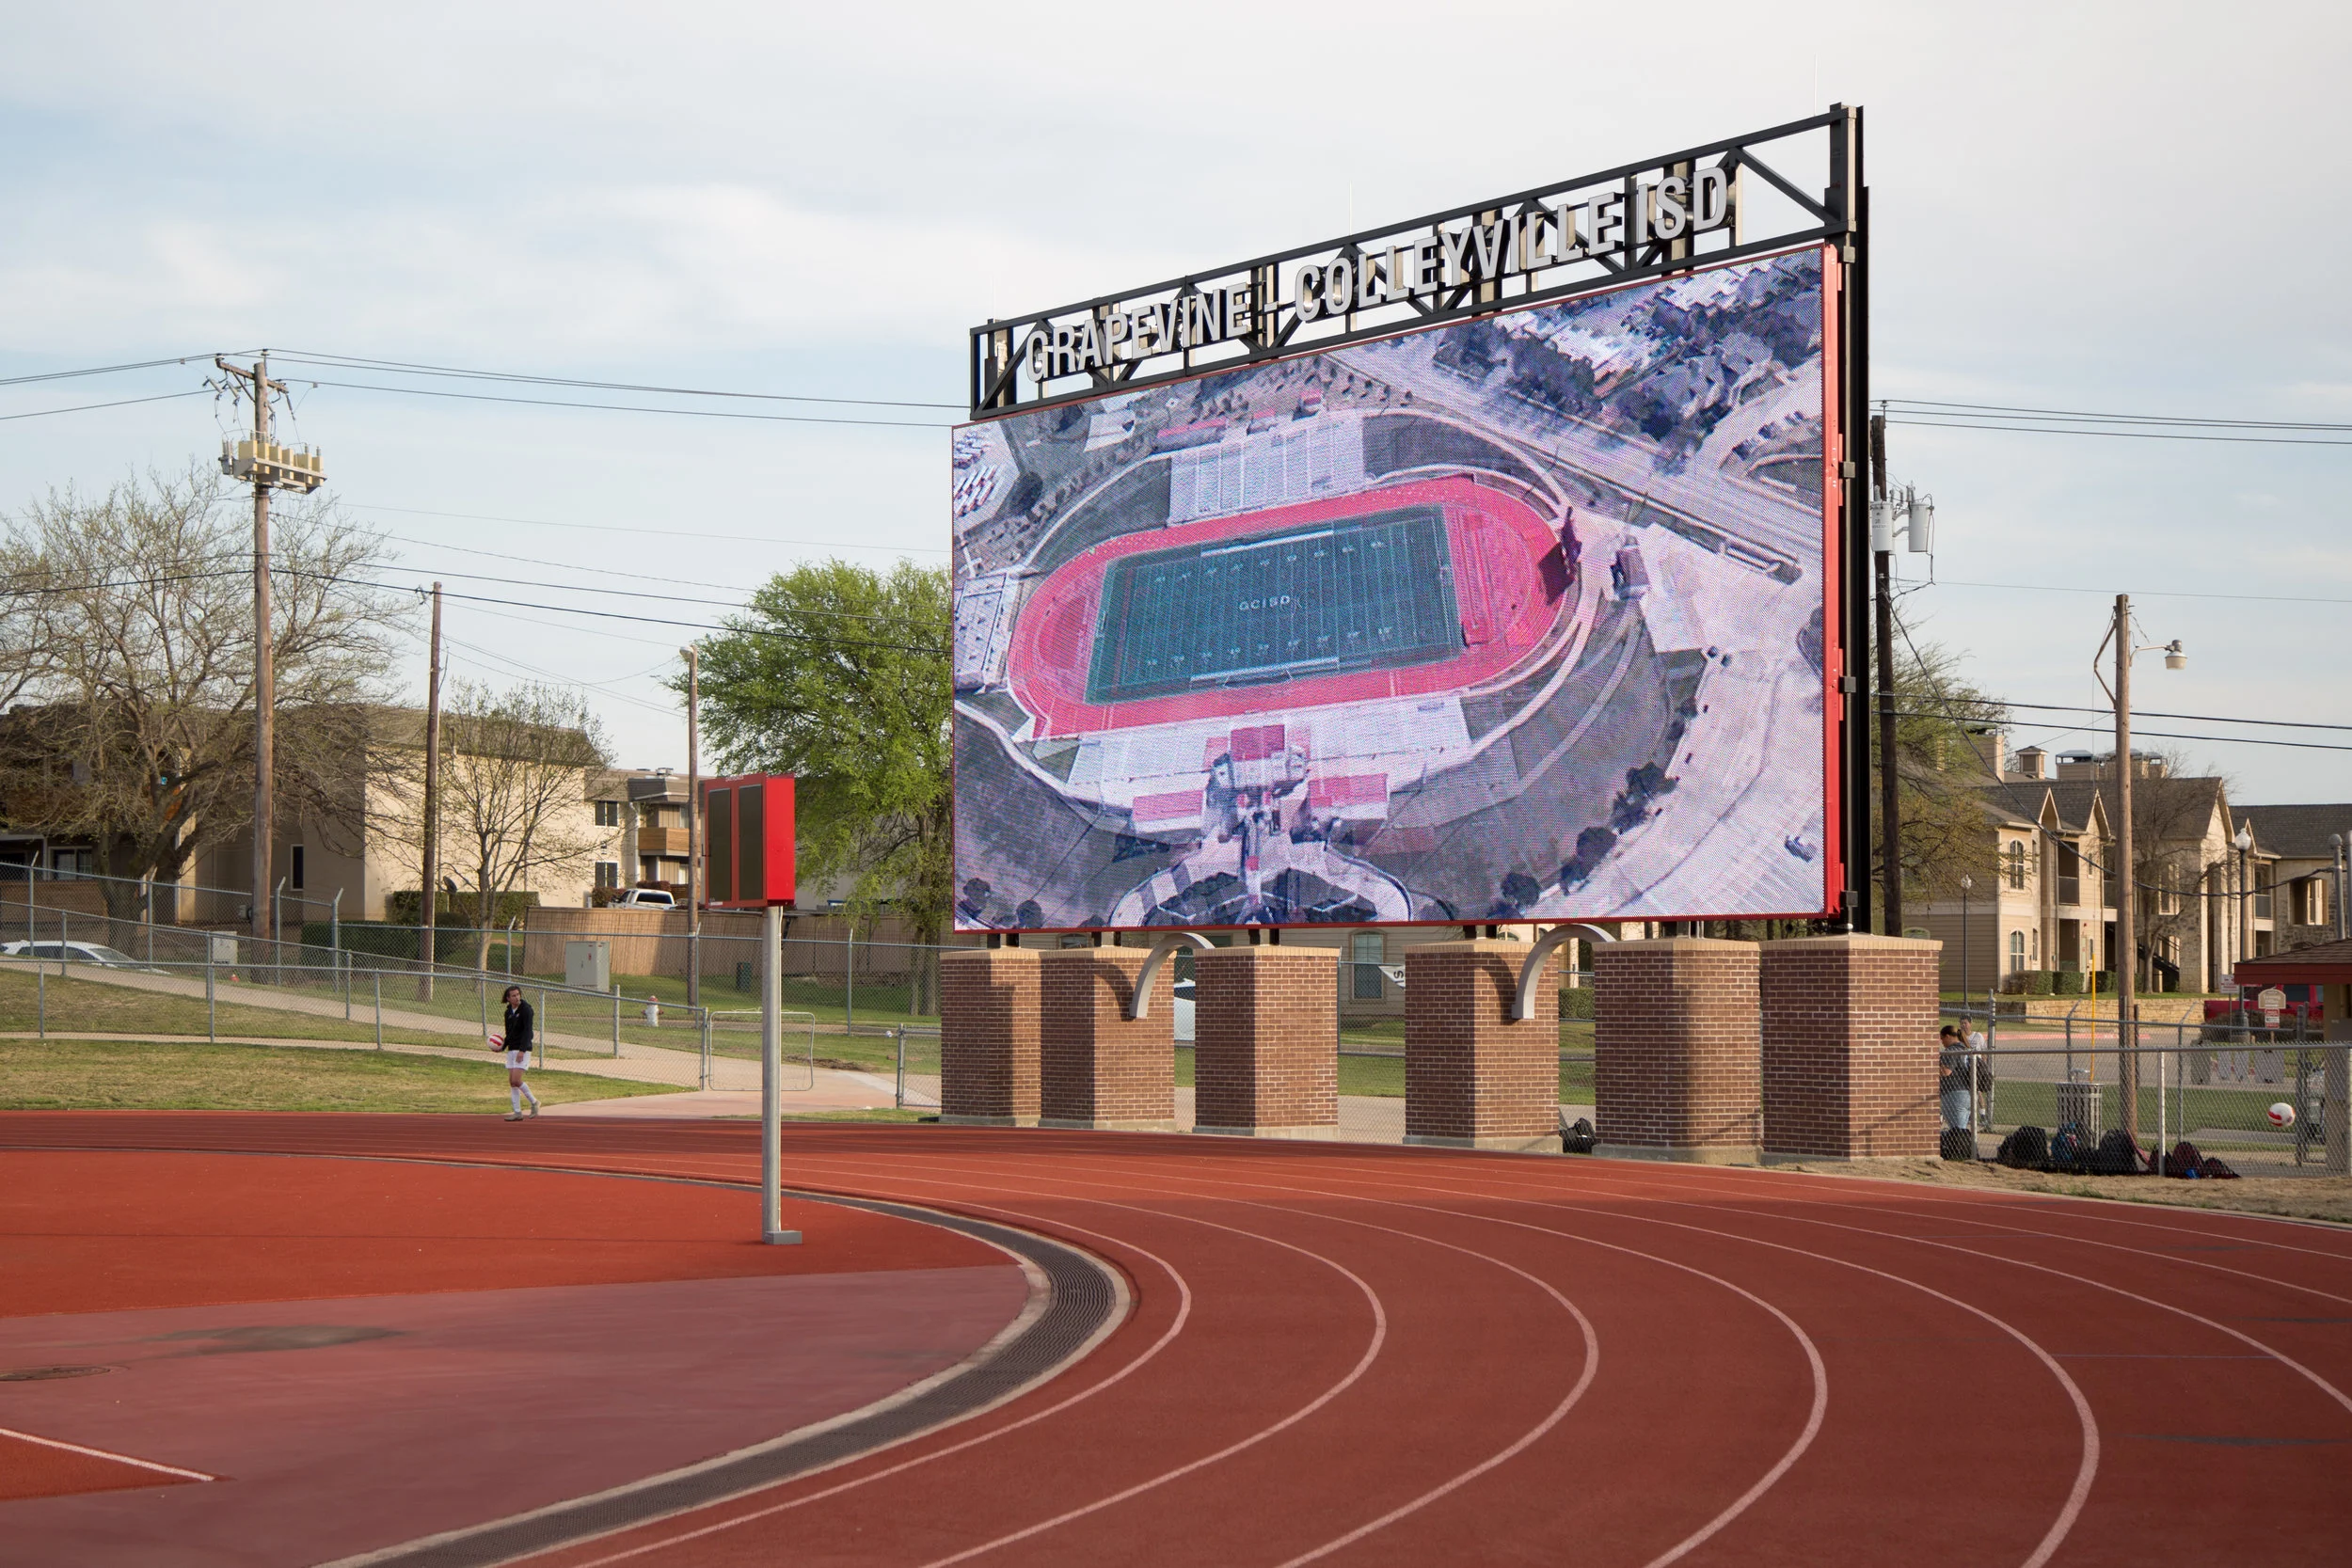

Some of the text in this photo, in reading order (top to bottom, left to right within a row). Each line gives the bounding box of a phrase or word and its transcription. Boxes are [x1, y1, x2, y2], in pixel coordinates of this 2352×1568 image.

[1025, 282, 1248, 383] GRAPEVINE
[1295, 192, 1616, 322] COLLEYVILLE
[1637, 166, 1727, 245] ISD
